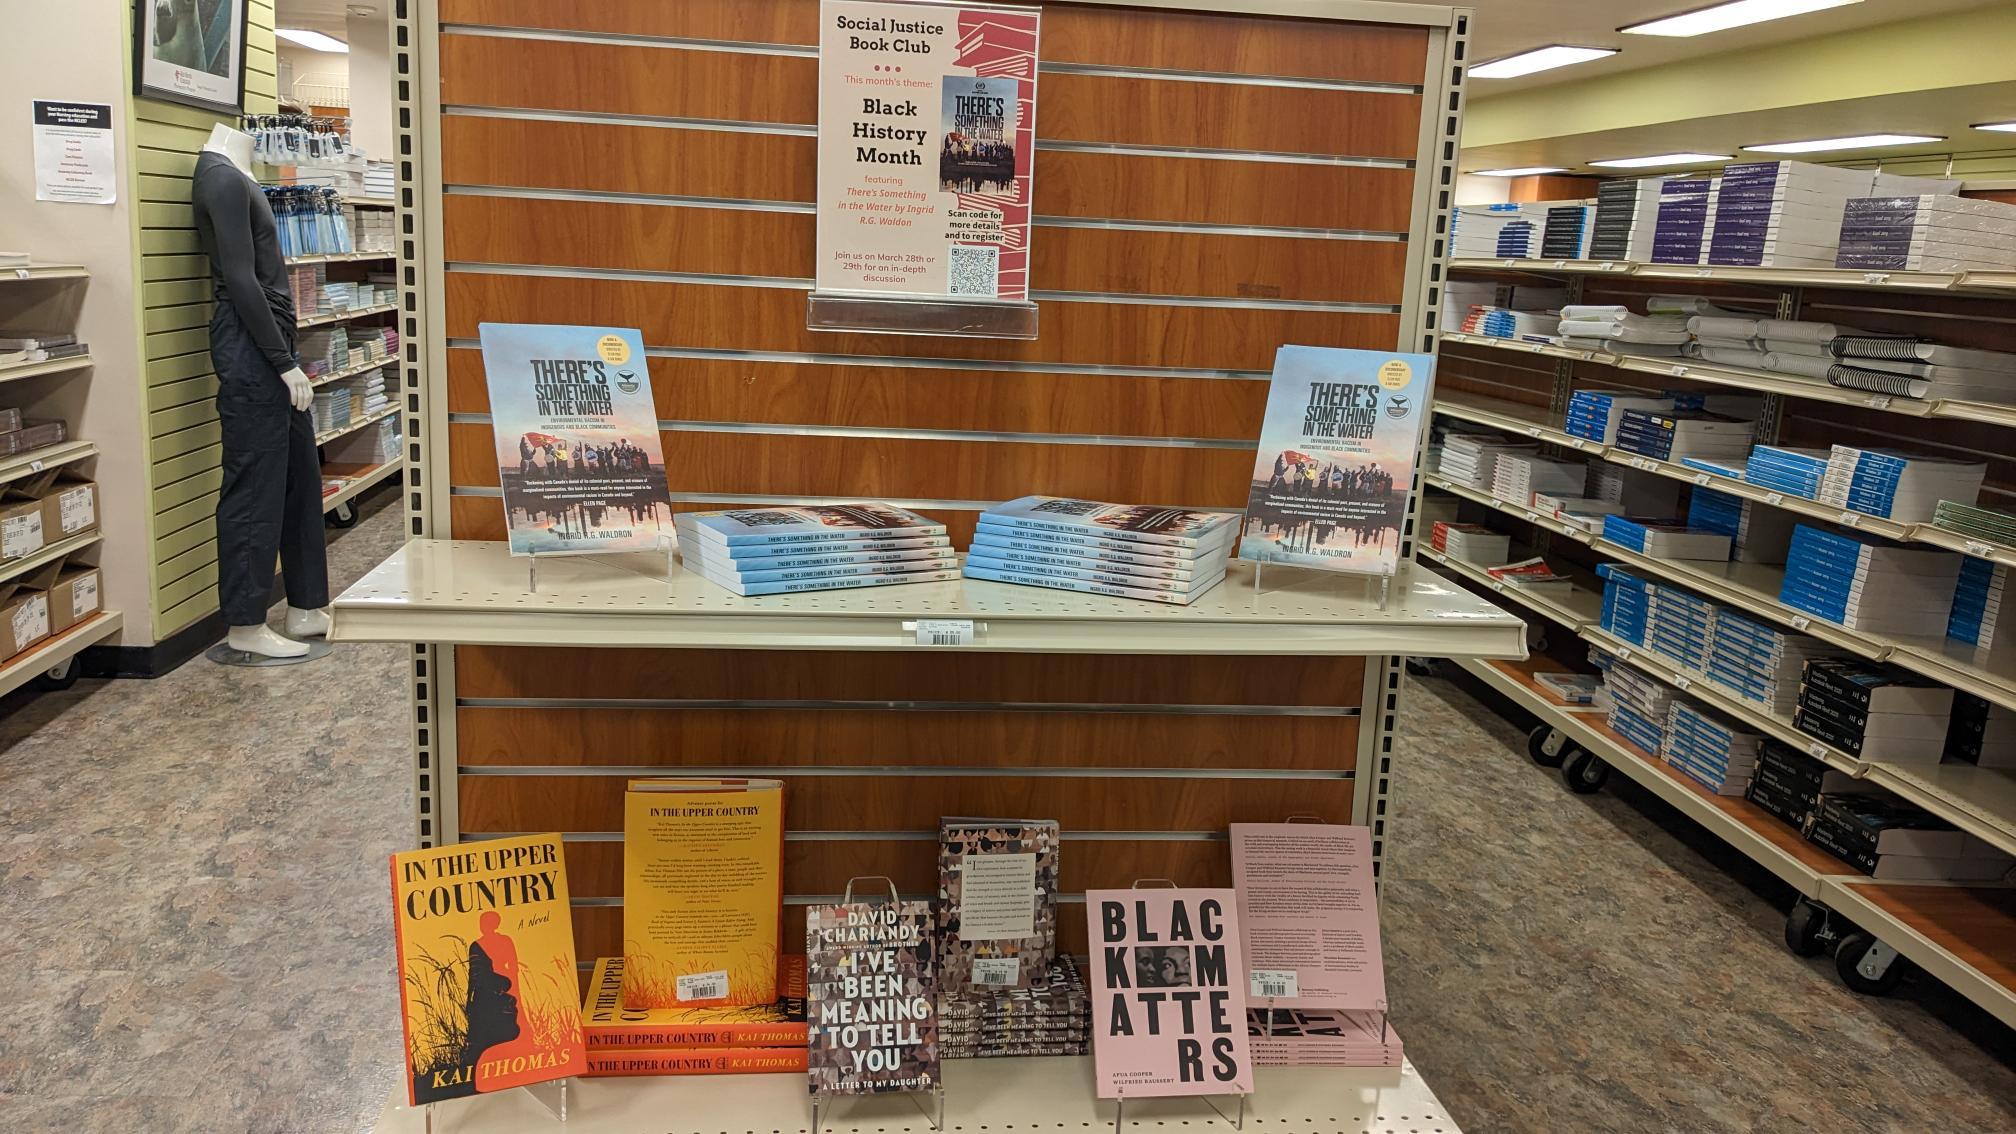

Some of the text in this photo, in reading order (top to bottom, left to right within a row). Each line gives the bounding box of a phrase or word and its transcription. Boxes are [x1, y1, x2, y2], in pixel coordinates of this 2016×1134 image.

[837, 15, 943, 35] Social Justice
[850, 37, 930, 54] Book Club
[844, 75, 933, 88] This month's theme:
[863, 99, 917, 116] Black
[956, 95, 1004, 116] THERE'S
[955, 115, 1004, 130] SOMETHING
[853, 122, 927, 145] History
[964, 128, 977, 140] THE
[979, 129, 1003, 143] WATER
[856, 147, 921, 165] Month
[864, 175, 902, 186] featuring
[847, 188, 926, 200] There's Something
[838, 201, 934, 215] in the Water by Ingrid
[948, 210, 1002, 219] Scan code for
[860, 217, 877, 225] R.G.
[973, 221, 1000, 230] details
[945, 232, 1004, 242] and to register
[835, 251, 851, 260] Join
[878, 253, 903, 262] March
[905, 254, 924, 262] 28th
[926, 255, 935, 263] or
[843, 262, 861, 271] 29th
[864, 263, 876, 271] for
[891, 264, 926, 274] in-depth
[864, 274, 906, 283] discussion
[530, 360, 607, 384] THERE'S
[535, 384, 611, 401] SOMETHING
[1310, 382, 1379, 408] THERE'S
[538, 401, 613, 416] IN THE WATER
[1305, 406, 1377, 425] SOMETHING
[1303, 422, 1374, 439] IN THE WATER
[558, 531, 582, 540] INGRID
[600, 530, 632, 538] WALDRON
[1320, 548, 1352, 558] WALDRON
[650, 806, 759, 817] IN THE UPPER COUNTRY
[404, 843, 558, 883] IN THE UPPER
[407, 870, 559, 921] COUNTRY
[518, 911, 550, 931] A Novel
[848, 910, 897, 926] DAVID
[1102, 899, 1223, 942] BLAC
[824, 925, 920, 943] CHARIANDY
[851, 951, 895, 974] I'VE
[1104, 947, 1131, 989] K
[1195, 945, 1228, 987] M
[601, 960, 624, 989] UPPER
[845, 975, 903, 999] BEEN
[595, 992, 617, 1010] THE
[787, 991, 802, 1014] KAI
[592, 1012, 613, 1021] IN
[821, 998, 927, 1025] MEANING
[1110, 991, 1232, 1037] ATTE
[589, 1032, 806, 1045] IN THE UPPER COUNTRY KAI THOMAS
[828, 1023, 922, 1049] TO TELL
[432, 1048, 571, 1089] KAI THOMAS
[598, 1061, 620, 1071] THE
[621, 1060, 658, 1071] UPPER
[661, 1059, 713, 1070] COUNTRY
[732, 1059, 752, 1068] KAI
[755, 1058, 800, 1067] THOMAS
[851, 1048, 900, 1073] YOU
[1177, 1037, 1237, 1083] RS
[831, 1081, 860, 1090] LETTER
[863, 1080, 873, 1088] TO
[876, 1079, 887, 1088] MY
[890, 1077, 931, 1087] DAUGHTER
